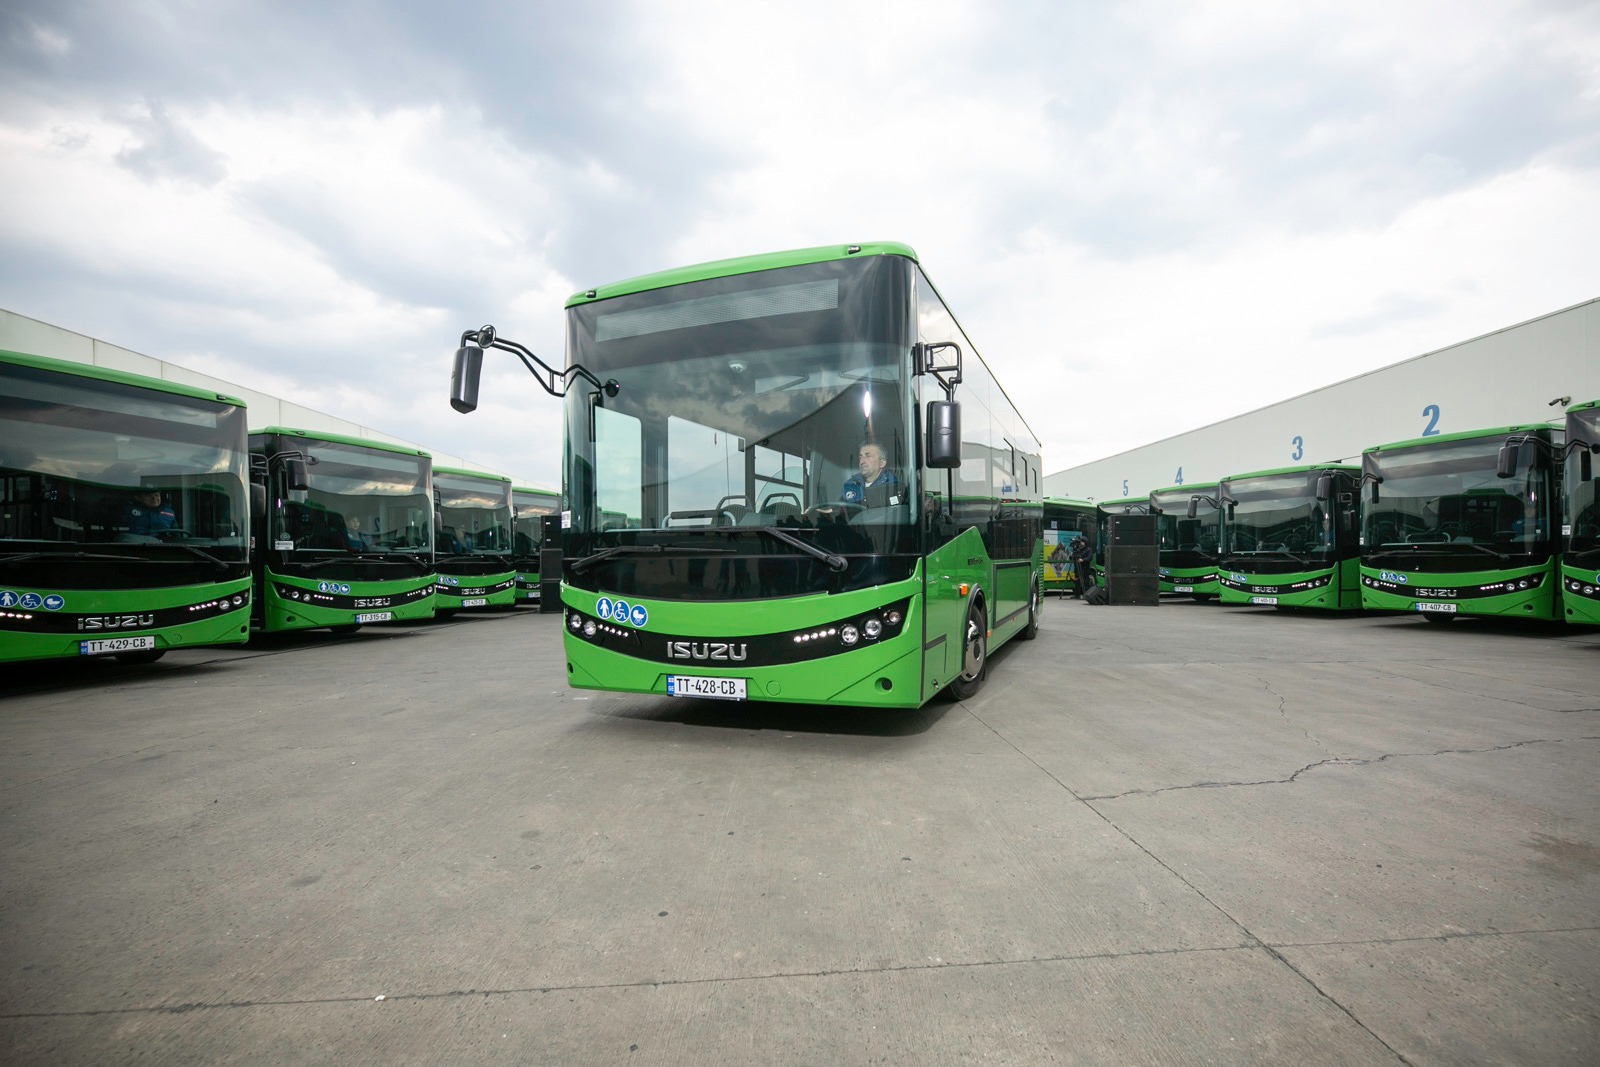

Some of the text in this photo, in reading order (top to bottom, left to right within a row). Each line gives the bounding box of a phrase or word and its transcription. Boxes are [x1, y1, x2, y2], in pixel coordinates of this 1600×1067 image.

[1422, 404, 1441, 436] 2
[1291, 436, 1303, 460] 3
[1174, 466, 1184, 485] 4
[1122, 479, 1129, 496] 5
[1415, 588, 1457, 597] ISUZU
[354, 597, 391, 607] ISUZU
[1420, 603, 1452, 611] TT-407-CB
[77, 614, 154, 630] ISUZU
[361, 612, 388, 621] TT-315-CB
[89, 638, 147, 652] TT-429-CB
[667, 641, 747, 661] ISUZU
[676, 678, 737, 695] TT-428-CB
